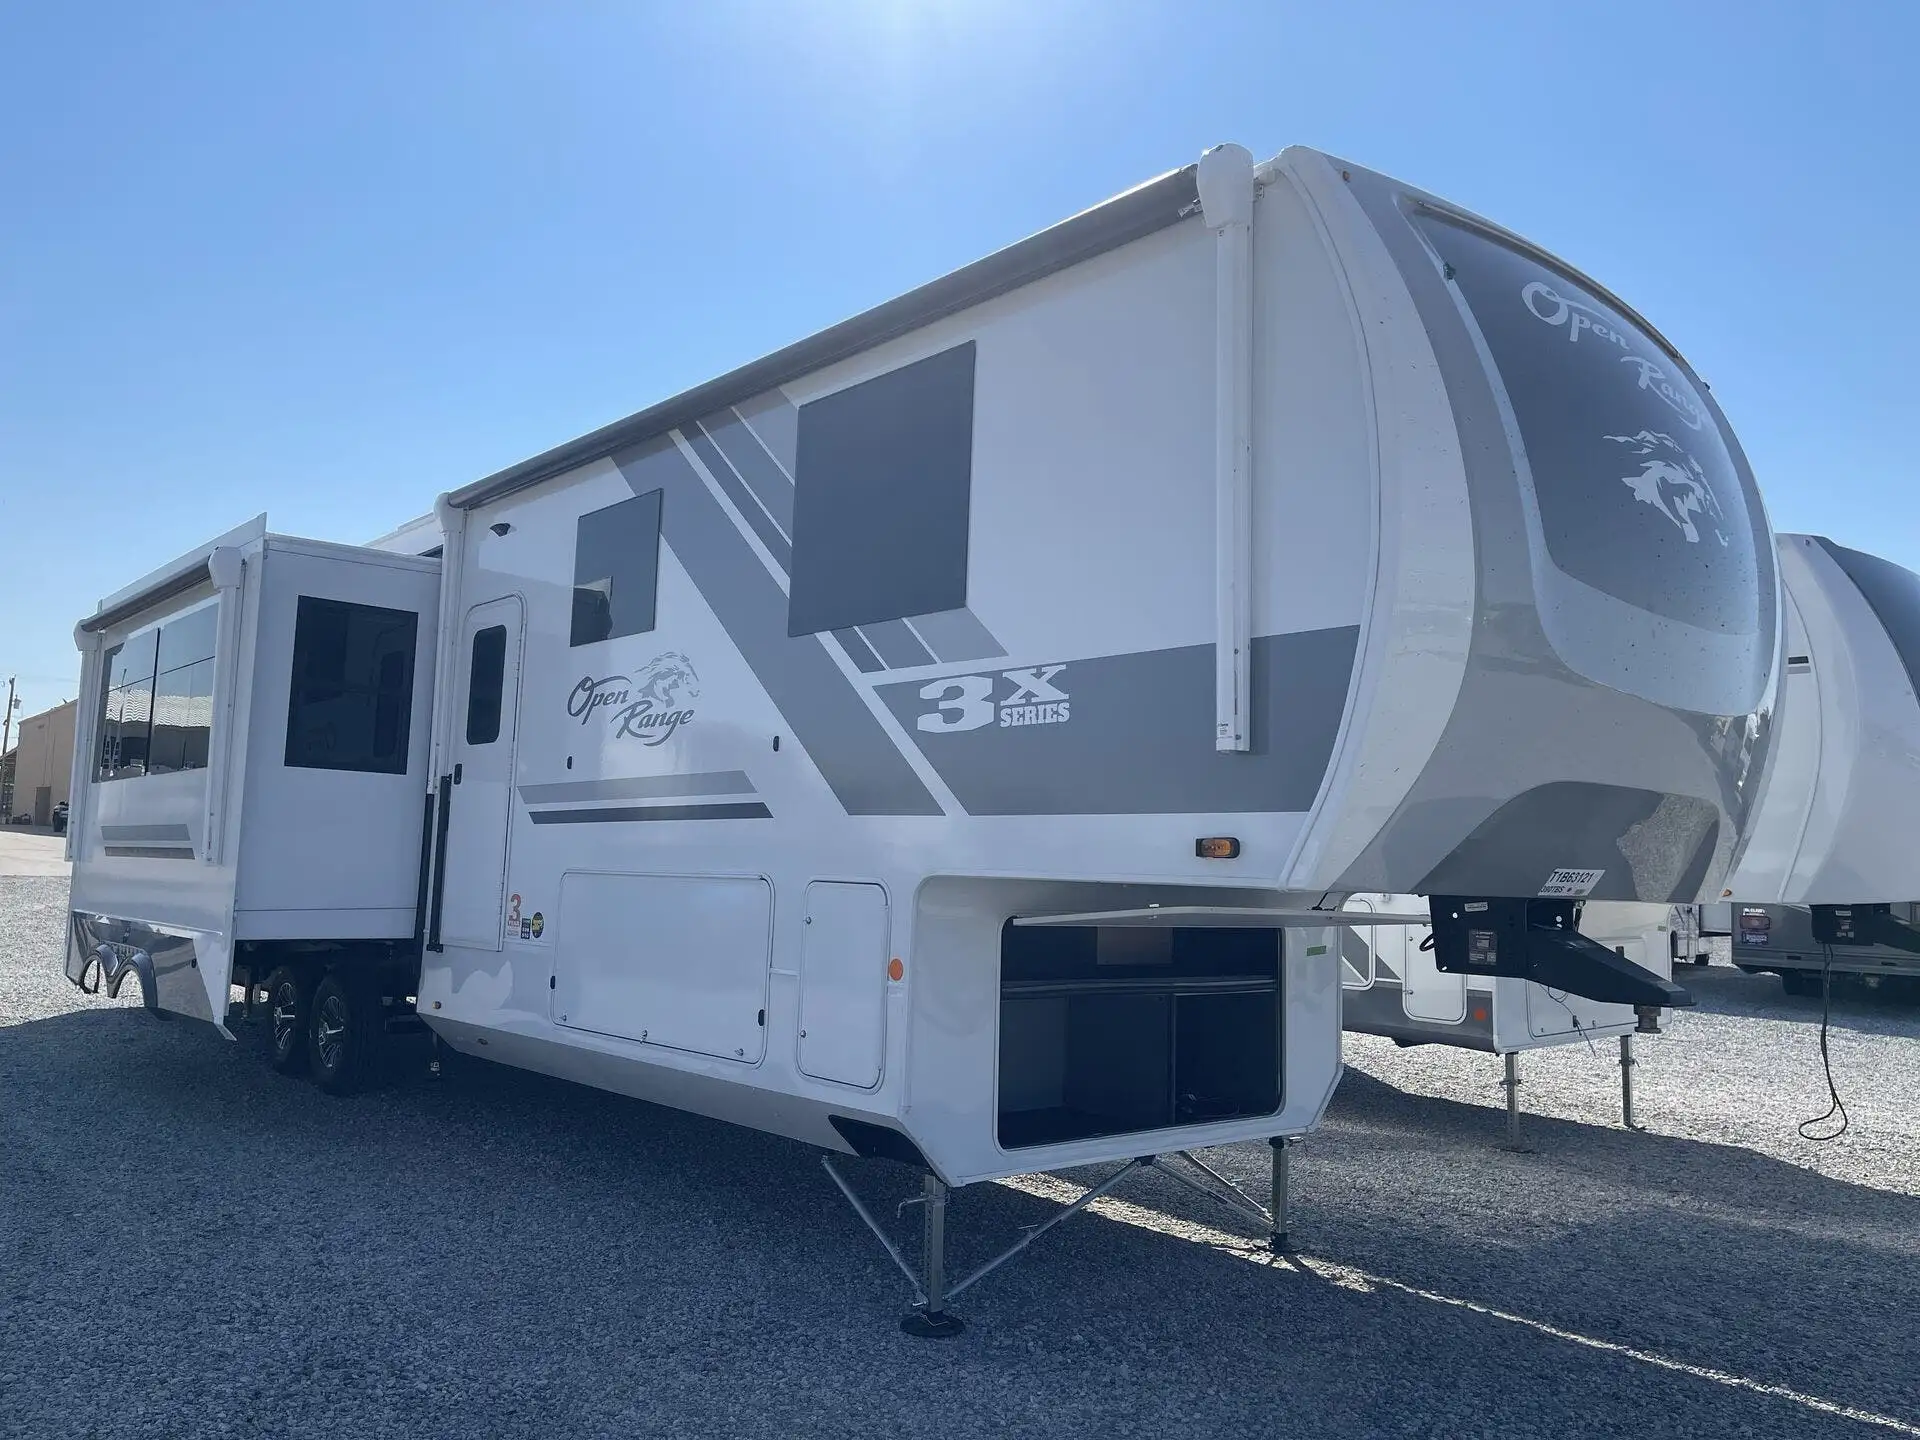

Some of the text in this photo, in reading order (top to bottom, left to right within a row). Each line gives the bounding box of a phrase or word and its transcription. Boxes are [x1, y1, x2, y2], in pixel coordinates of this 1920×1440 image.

[1521, 281, 1630, 350] Open
[567, 675, 632, 725] Open
[610, 700, 695, 747] Range
[1000, 702, 1070, 728] SERIES
[1549, 871, 1595, 883] T1B63121
